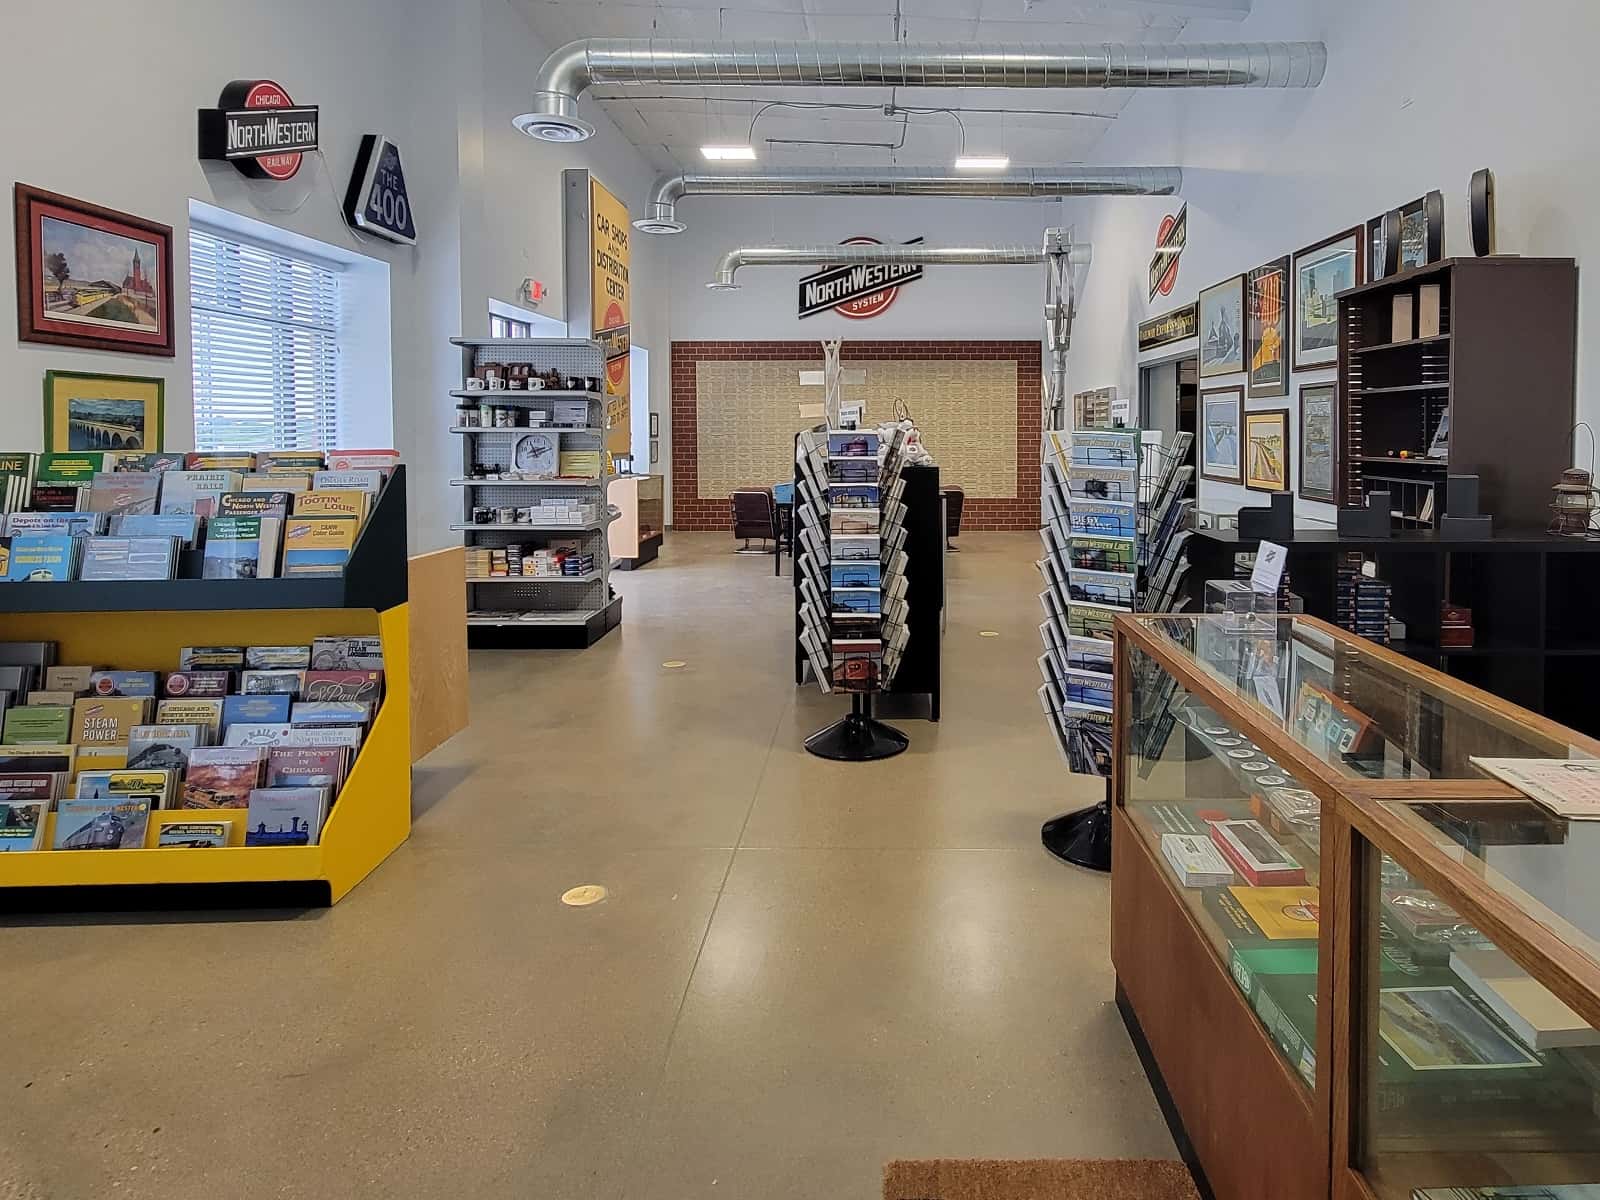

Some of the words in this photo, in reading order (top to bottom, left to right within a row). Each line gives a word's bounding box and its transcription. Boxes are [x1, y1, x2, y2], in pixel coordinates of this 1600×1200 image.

[255, 95, 281, 105] CHICAGO
[266, 156, 294, 168] RAILWAY
[381, 169, 399, 191] THE
[369, 184, 407, 230] 400
[596, 213, 610, 237] CAR
[611, 224, 628, 251] SHOPS
[607, 242, 620, 258] AND
[596, 249, 629, 285] DISTRIBUTION
[606, 277, 625, 301] CENTER
[852, 293, 884, 311] SYSTEM
[0, 460, 22, 471] INE
[324, 503, 356, 513] LOUIE
[84, 717, 119, 730] STEAM
[82, 730, 118, 742] POWER
[273, 750, 295, 758] THE
[298, 750, 337, 758] PENNSY
